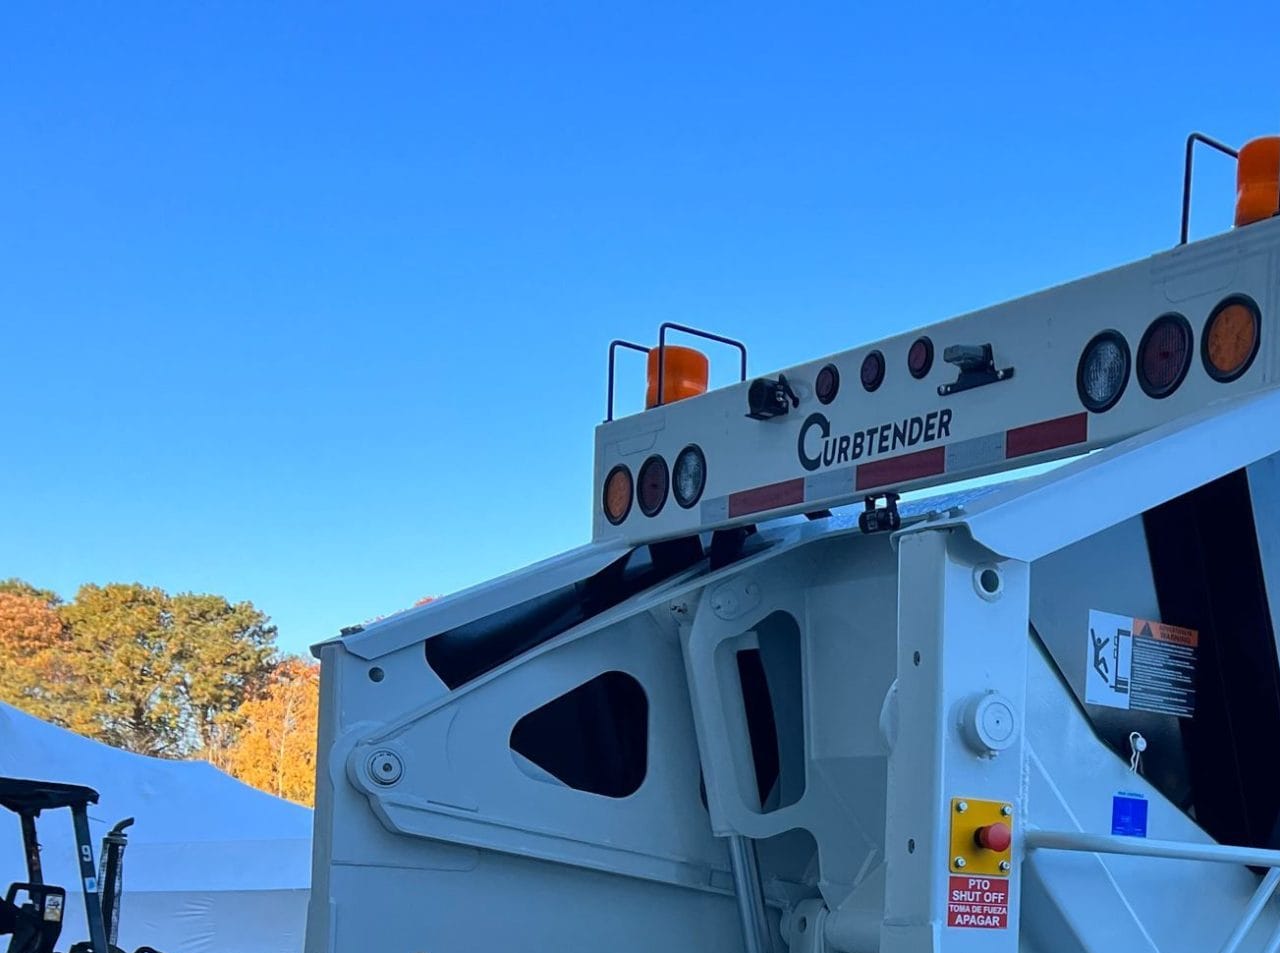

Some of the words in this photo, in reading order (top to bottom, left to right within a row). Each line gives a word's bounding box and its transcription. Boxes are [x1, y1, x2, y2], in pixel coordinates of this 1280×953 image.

[797, 408, 953, 472] CURBTENDER
[968, 879, 990, 890] PTO
[952, 890, 982, 902] SHUT
[983, 892, 1005, 904] OFF
[950, 904, 971, 913] TOMA
[971, 905, 982, 914] DE
[983, 906, 1007, 915] FUEZA
[955, 914, 1000, 926] APAGAR
